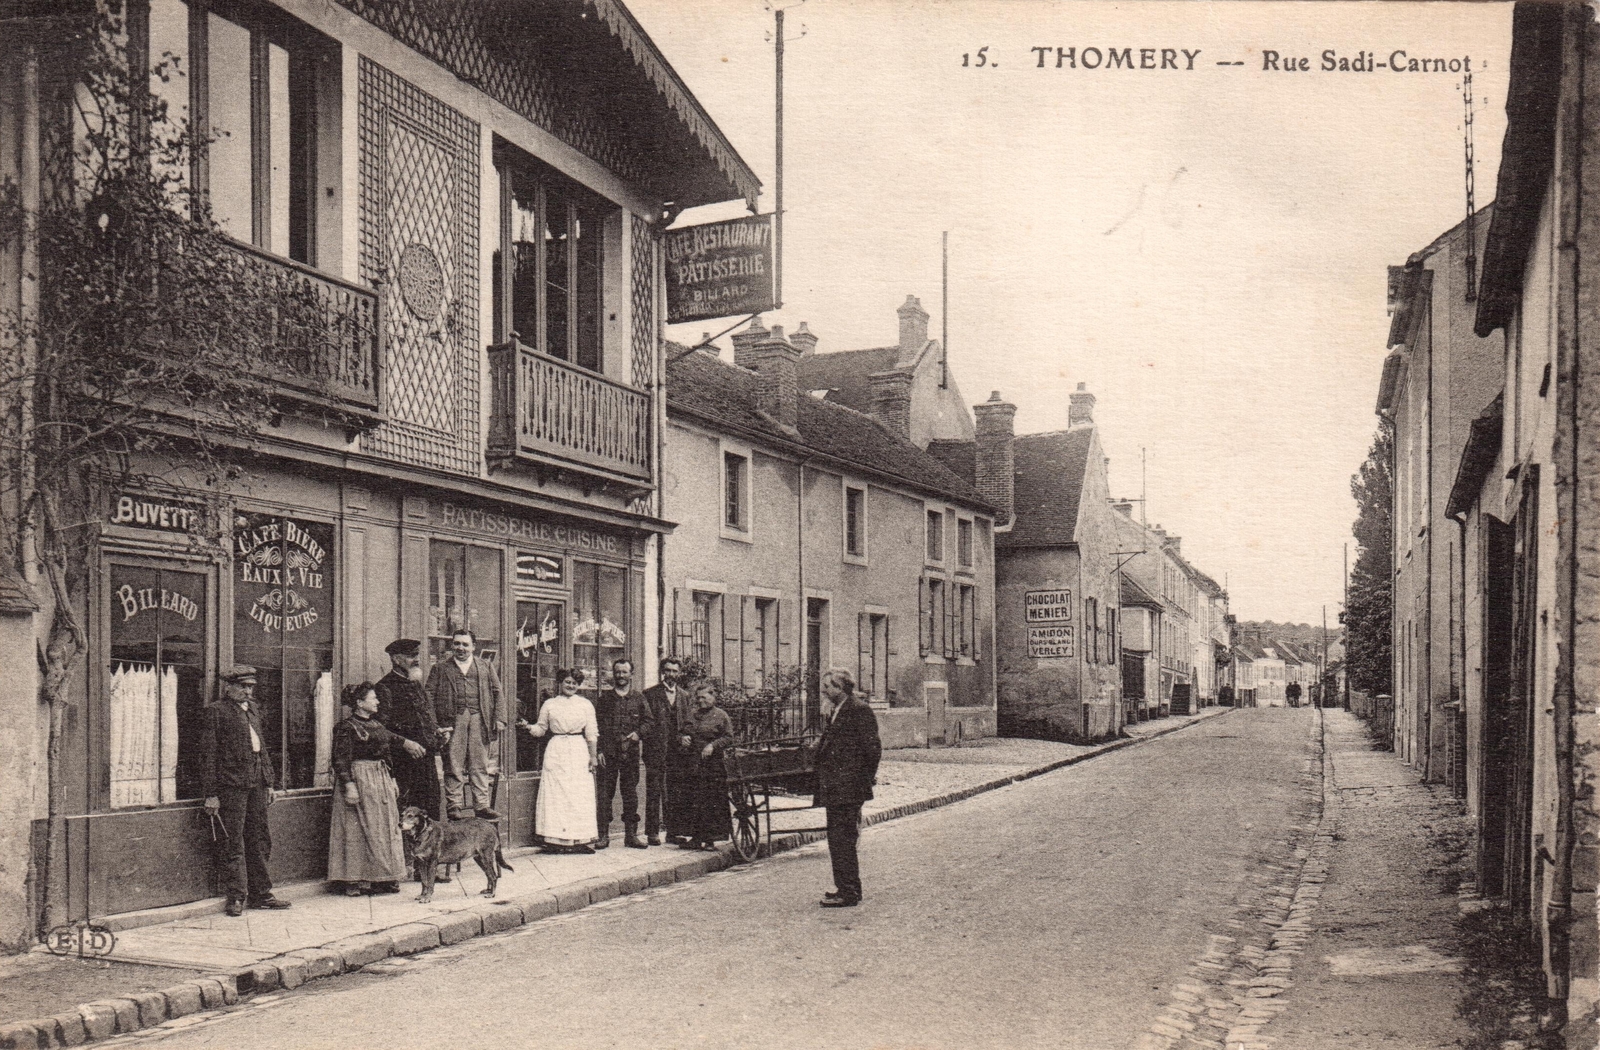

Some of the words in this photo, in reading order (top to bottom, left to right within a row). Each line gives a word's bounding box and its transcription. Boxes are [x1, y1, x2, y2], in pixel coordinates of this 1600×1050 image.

[691, 222, 771, 257] RESTAURANT
[554, 525, 618, 554] CUISINE
[241, 560, 282, 585] EAUX
[300, 567, 323, 589] VIE
[116, 584, 199, 622] BILLARD
[1027, 593, 1070, 606] CHOCOLAT
[1029, 607, 1068, 619] MENIER
[248, 602, 320, 633] LIQUEURS
[1031, 629, 1071, 638] AMIDON
[1031, 646, 1069, 655] VERLEY
